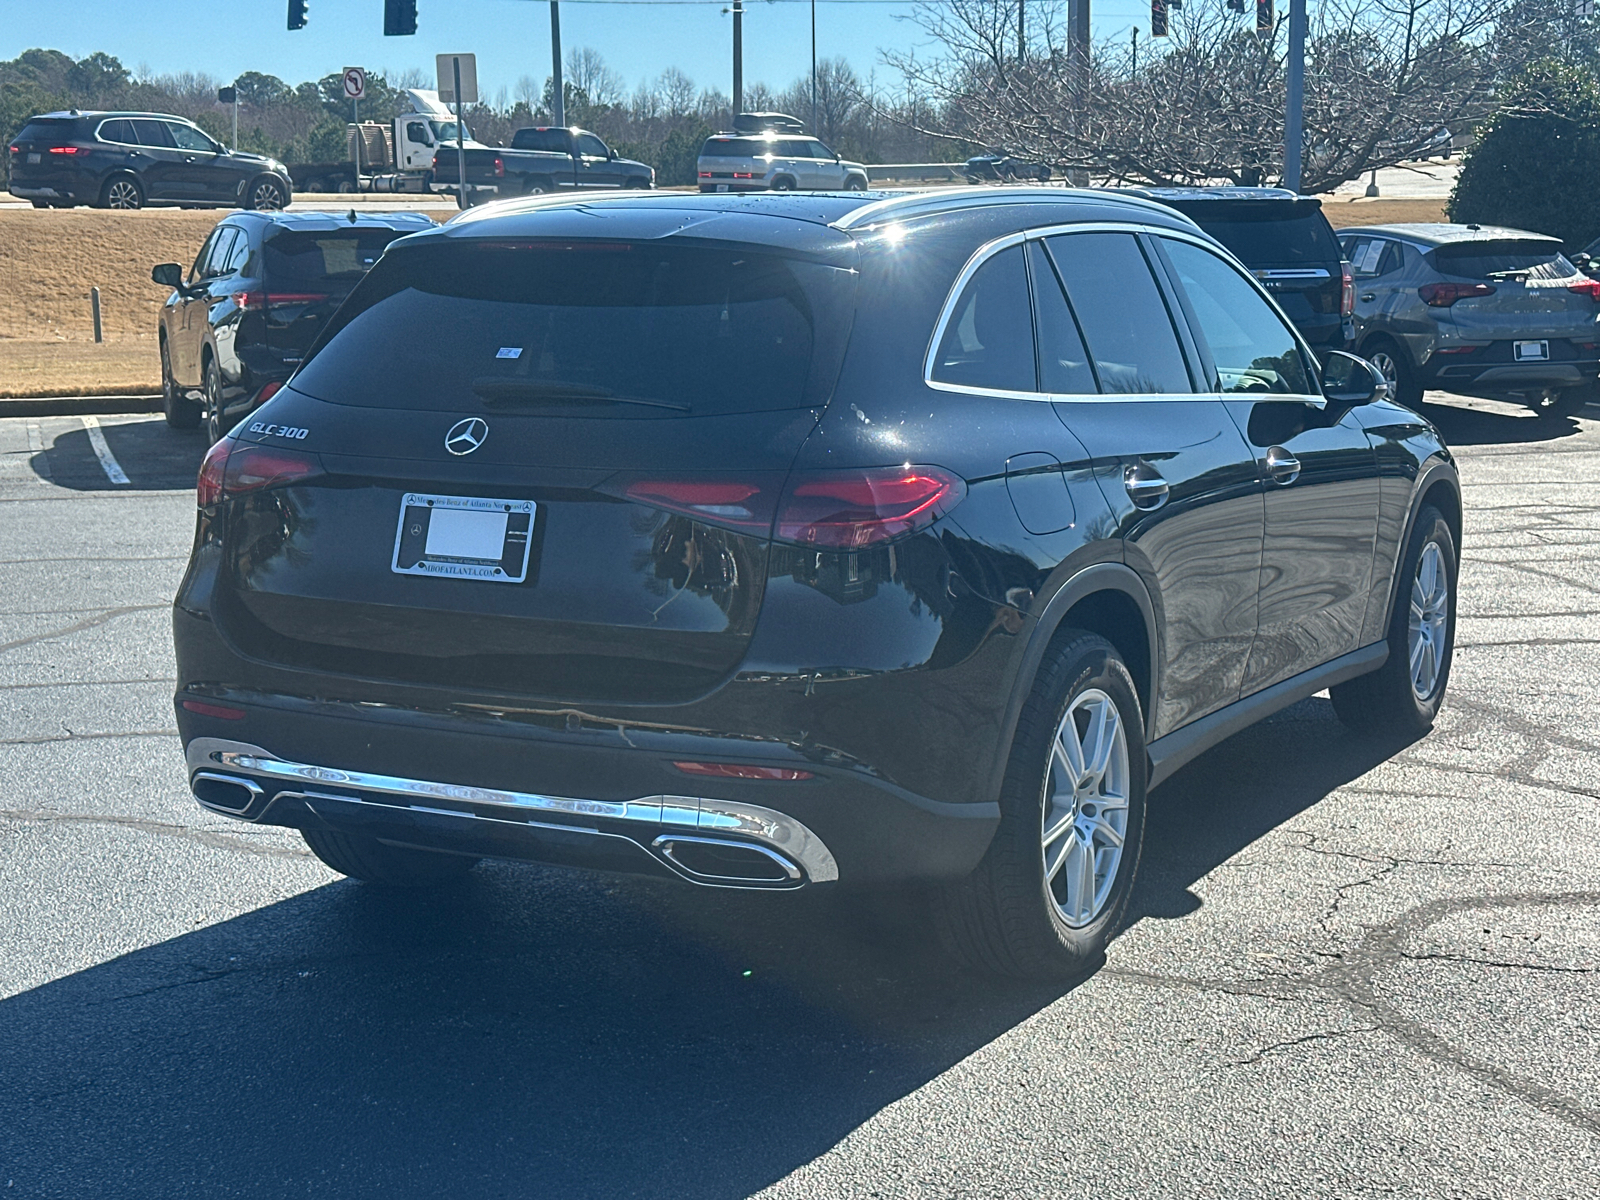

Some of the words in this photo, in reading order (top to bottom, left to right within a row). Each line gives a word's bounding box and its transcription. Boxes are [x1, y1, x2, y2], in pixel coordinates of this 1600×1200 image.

[249, 422, 278, 435] GLC
[275, 426, 310, 440] 300
[417, 496, 462, 506] Merdes-Benz
[462, 499, 470, 507] of
[470, 500, 492, 508] Atlanta
